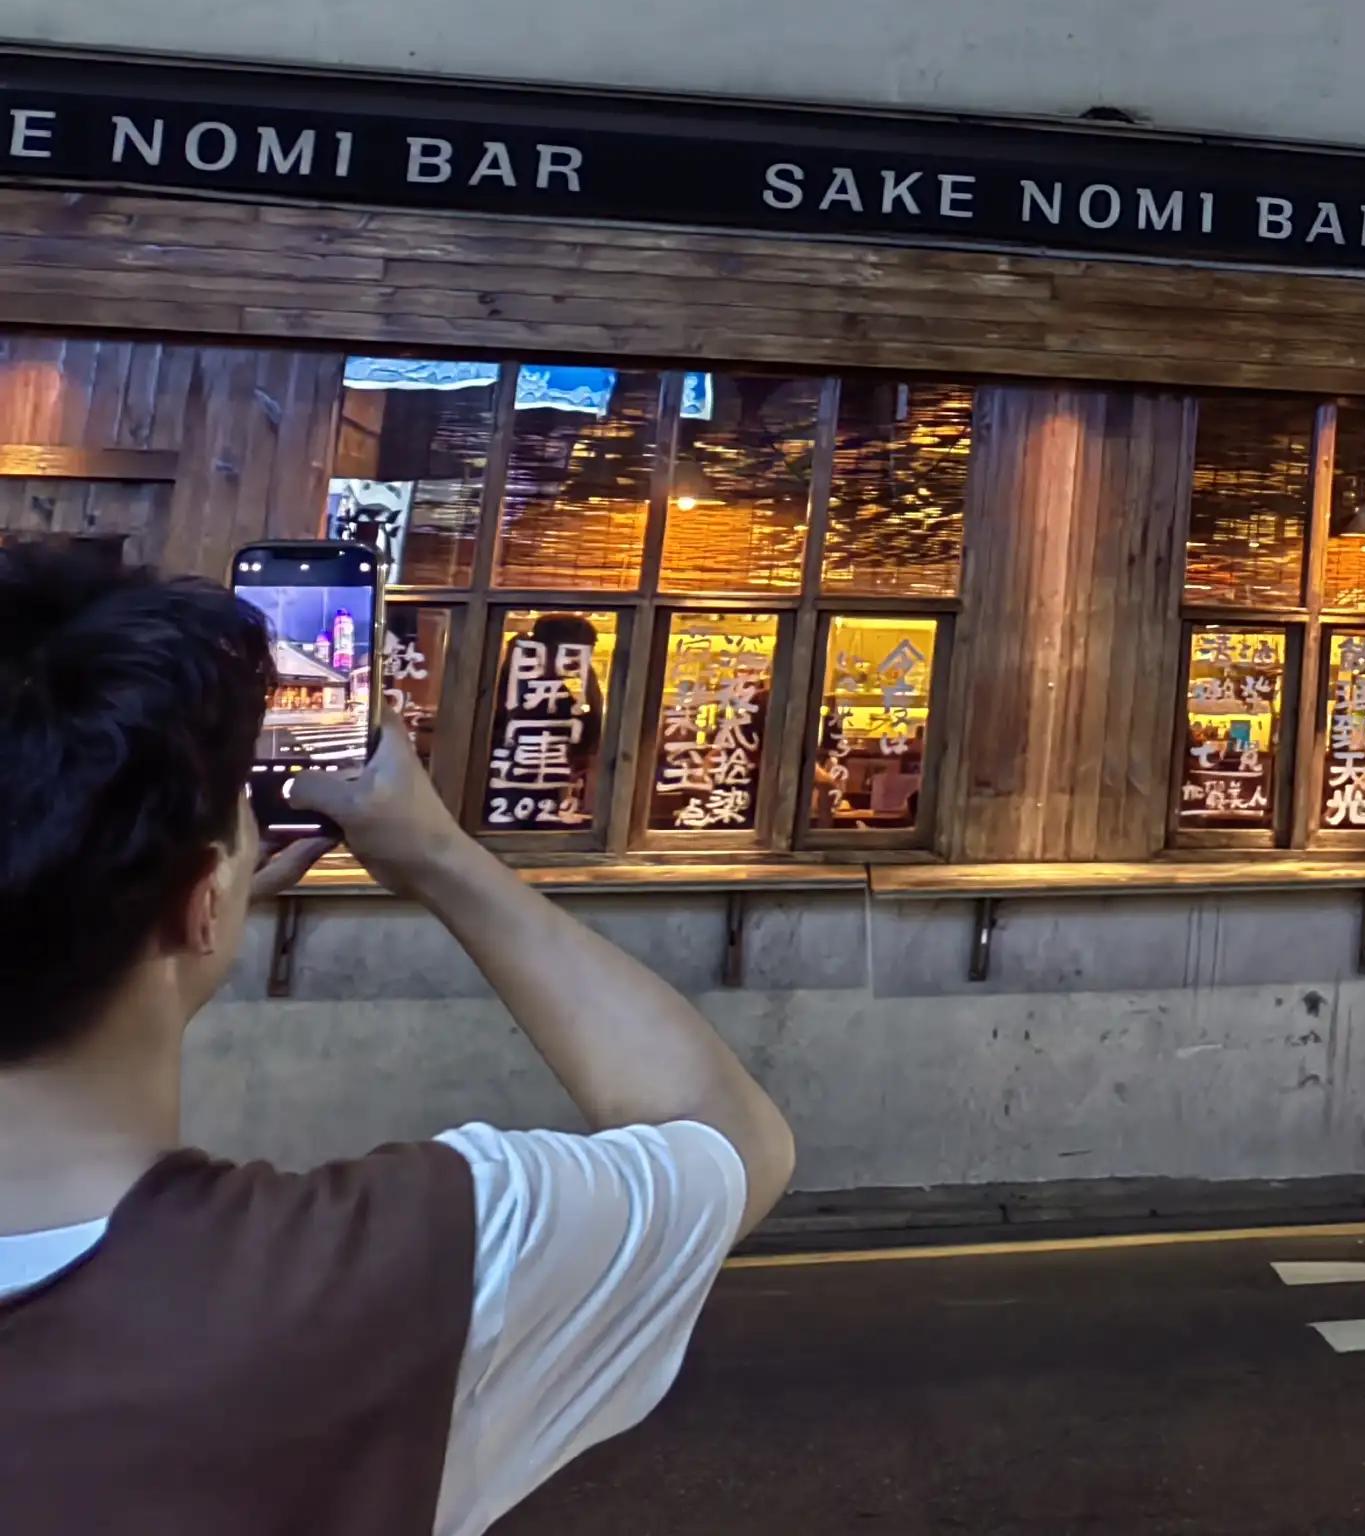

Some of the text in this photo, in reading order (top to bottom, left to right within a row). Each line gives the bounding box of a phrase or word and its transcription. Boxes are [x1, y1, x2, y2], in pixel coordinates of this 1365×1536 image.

[10, 109, 584, 192] E NOMI BAR
[762, 163, 976, 219] SAKE
[1020, 179, 1214, 233] NOMI
[490, 639, 593, 789] 開運
[488, 796, 593, 824] 2022
